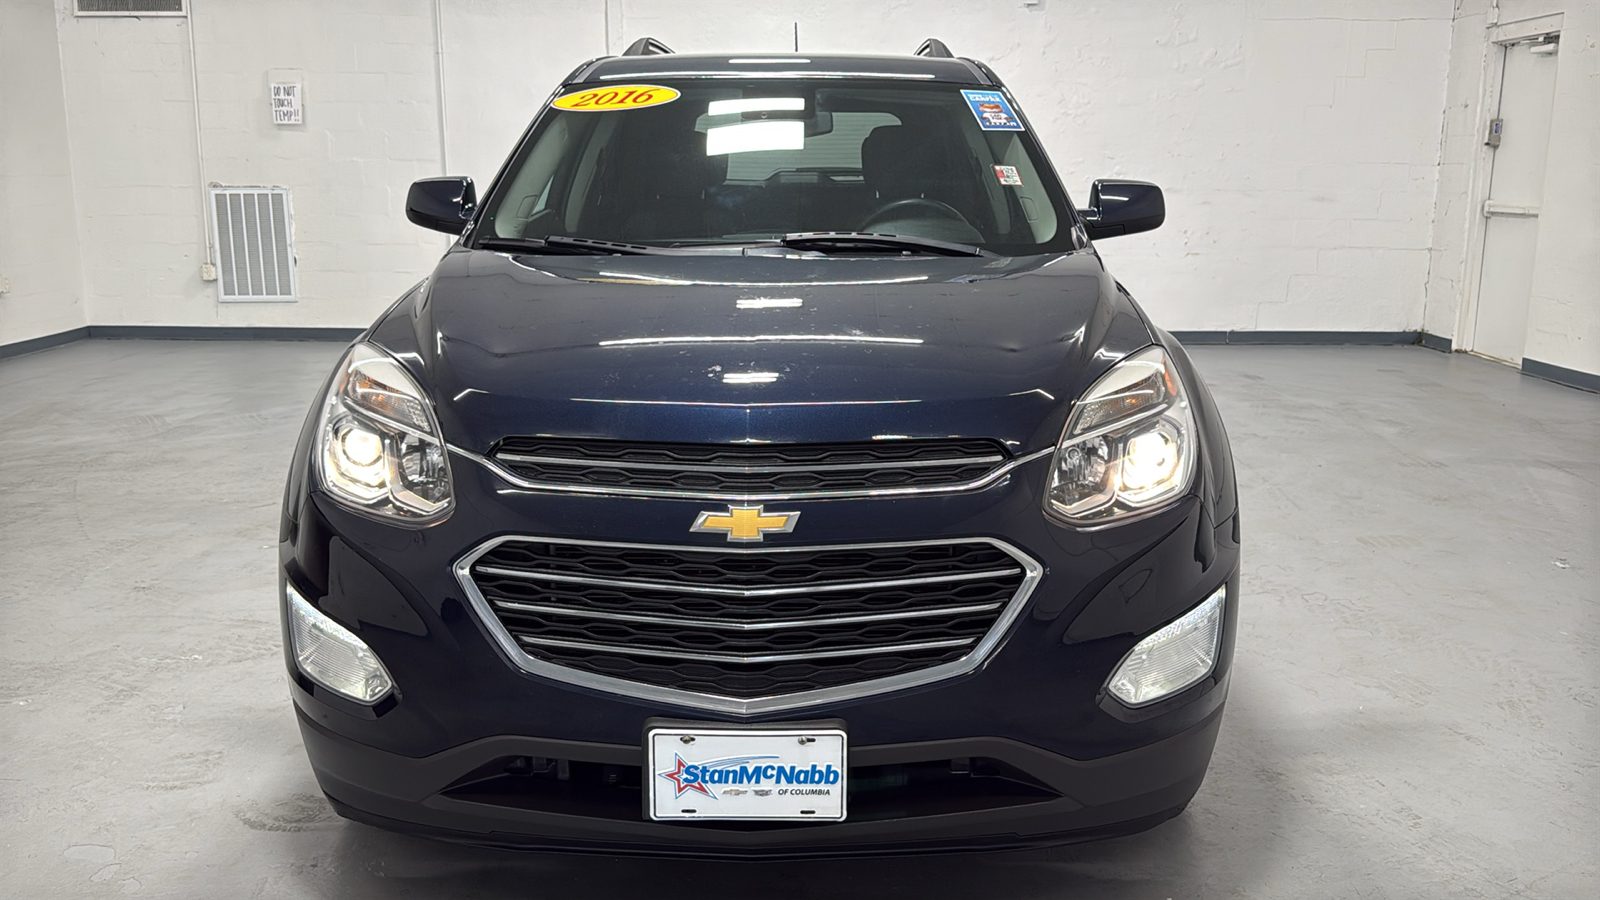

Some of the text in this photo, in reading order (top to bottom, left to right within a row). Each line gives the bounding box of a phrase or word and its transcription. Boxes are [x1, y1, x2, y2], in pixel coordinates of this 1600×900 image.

[274, 86, 296, 97] DO NOT
[571, 88, 660, 107] 2016
[273, 98, 293, 108] TOUCH
[274, 109, 300, 122] TEMP!!
